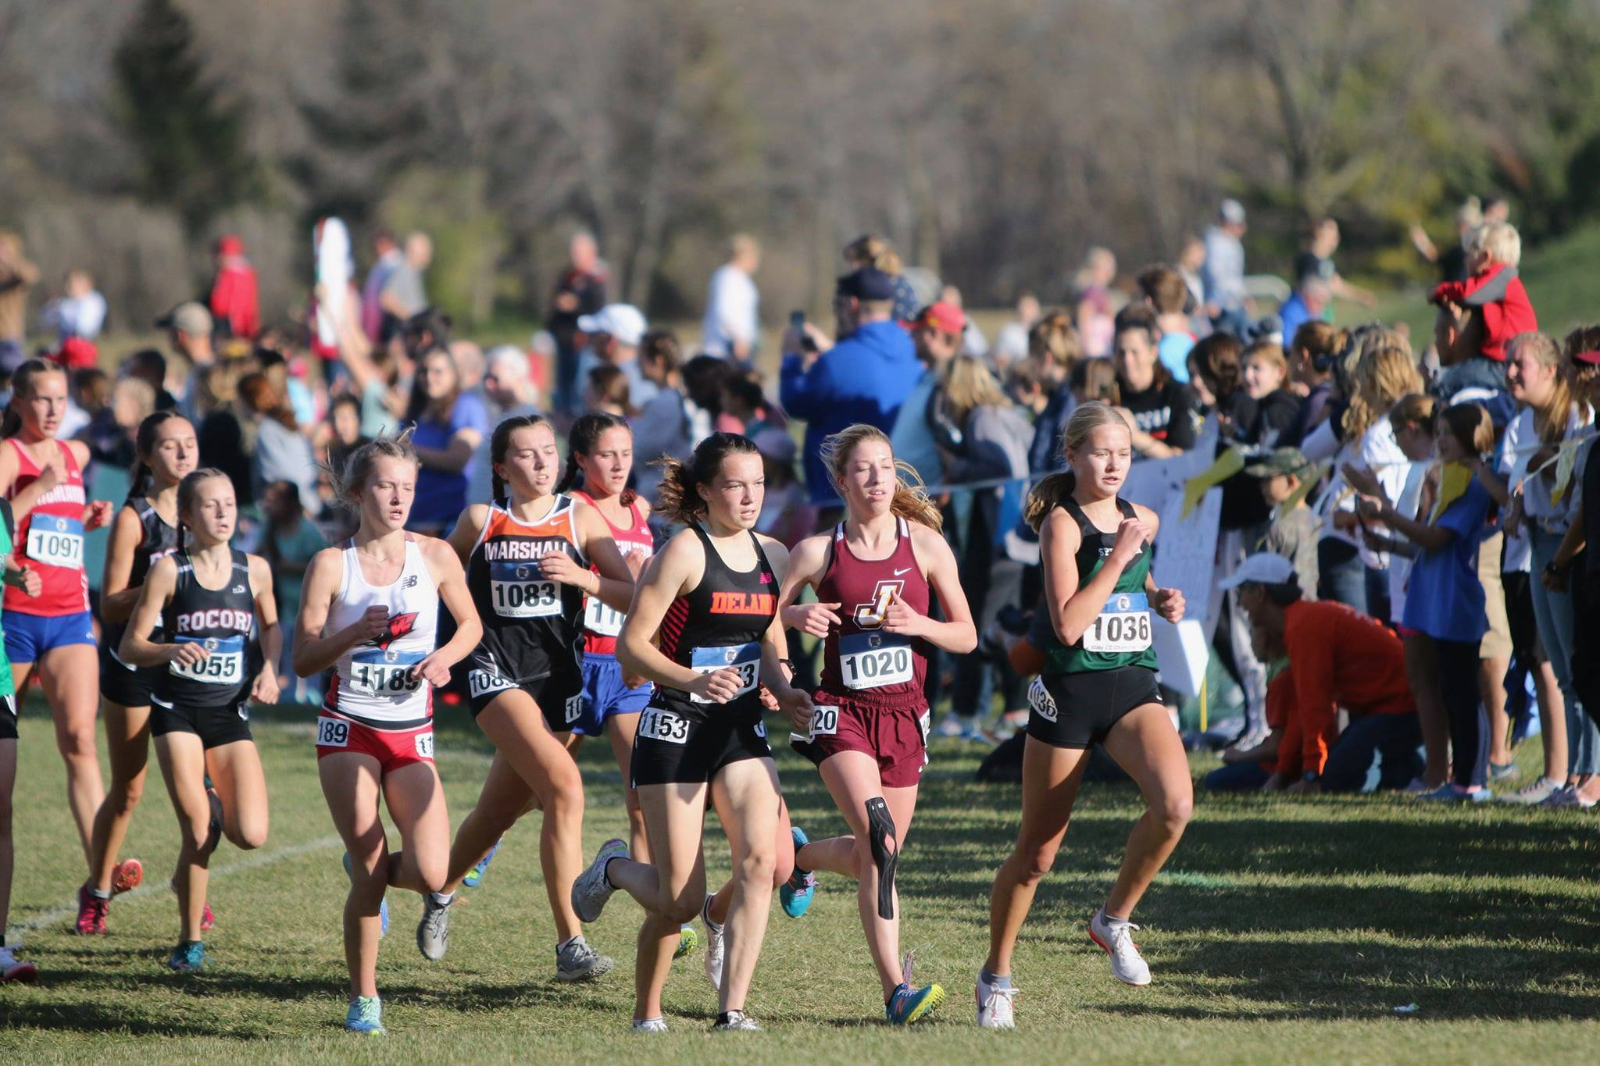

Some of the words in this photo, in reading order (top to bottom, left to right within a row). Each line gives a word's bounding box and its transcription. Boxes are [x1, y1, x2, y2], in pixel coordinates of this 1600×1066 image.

[35, 534, 79, 559] 1097
[495, 583, 556, 608] 1083
[853, 580, 904, 630] J
[1095, 615, 1148, 642] 1036
[846, 649, 908, 680] 1020
[358, 666, 419, 691] 1189
[641, 711, 687, 739] 1153
